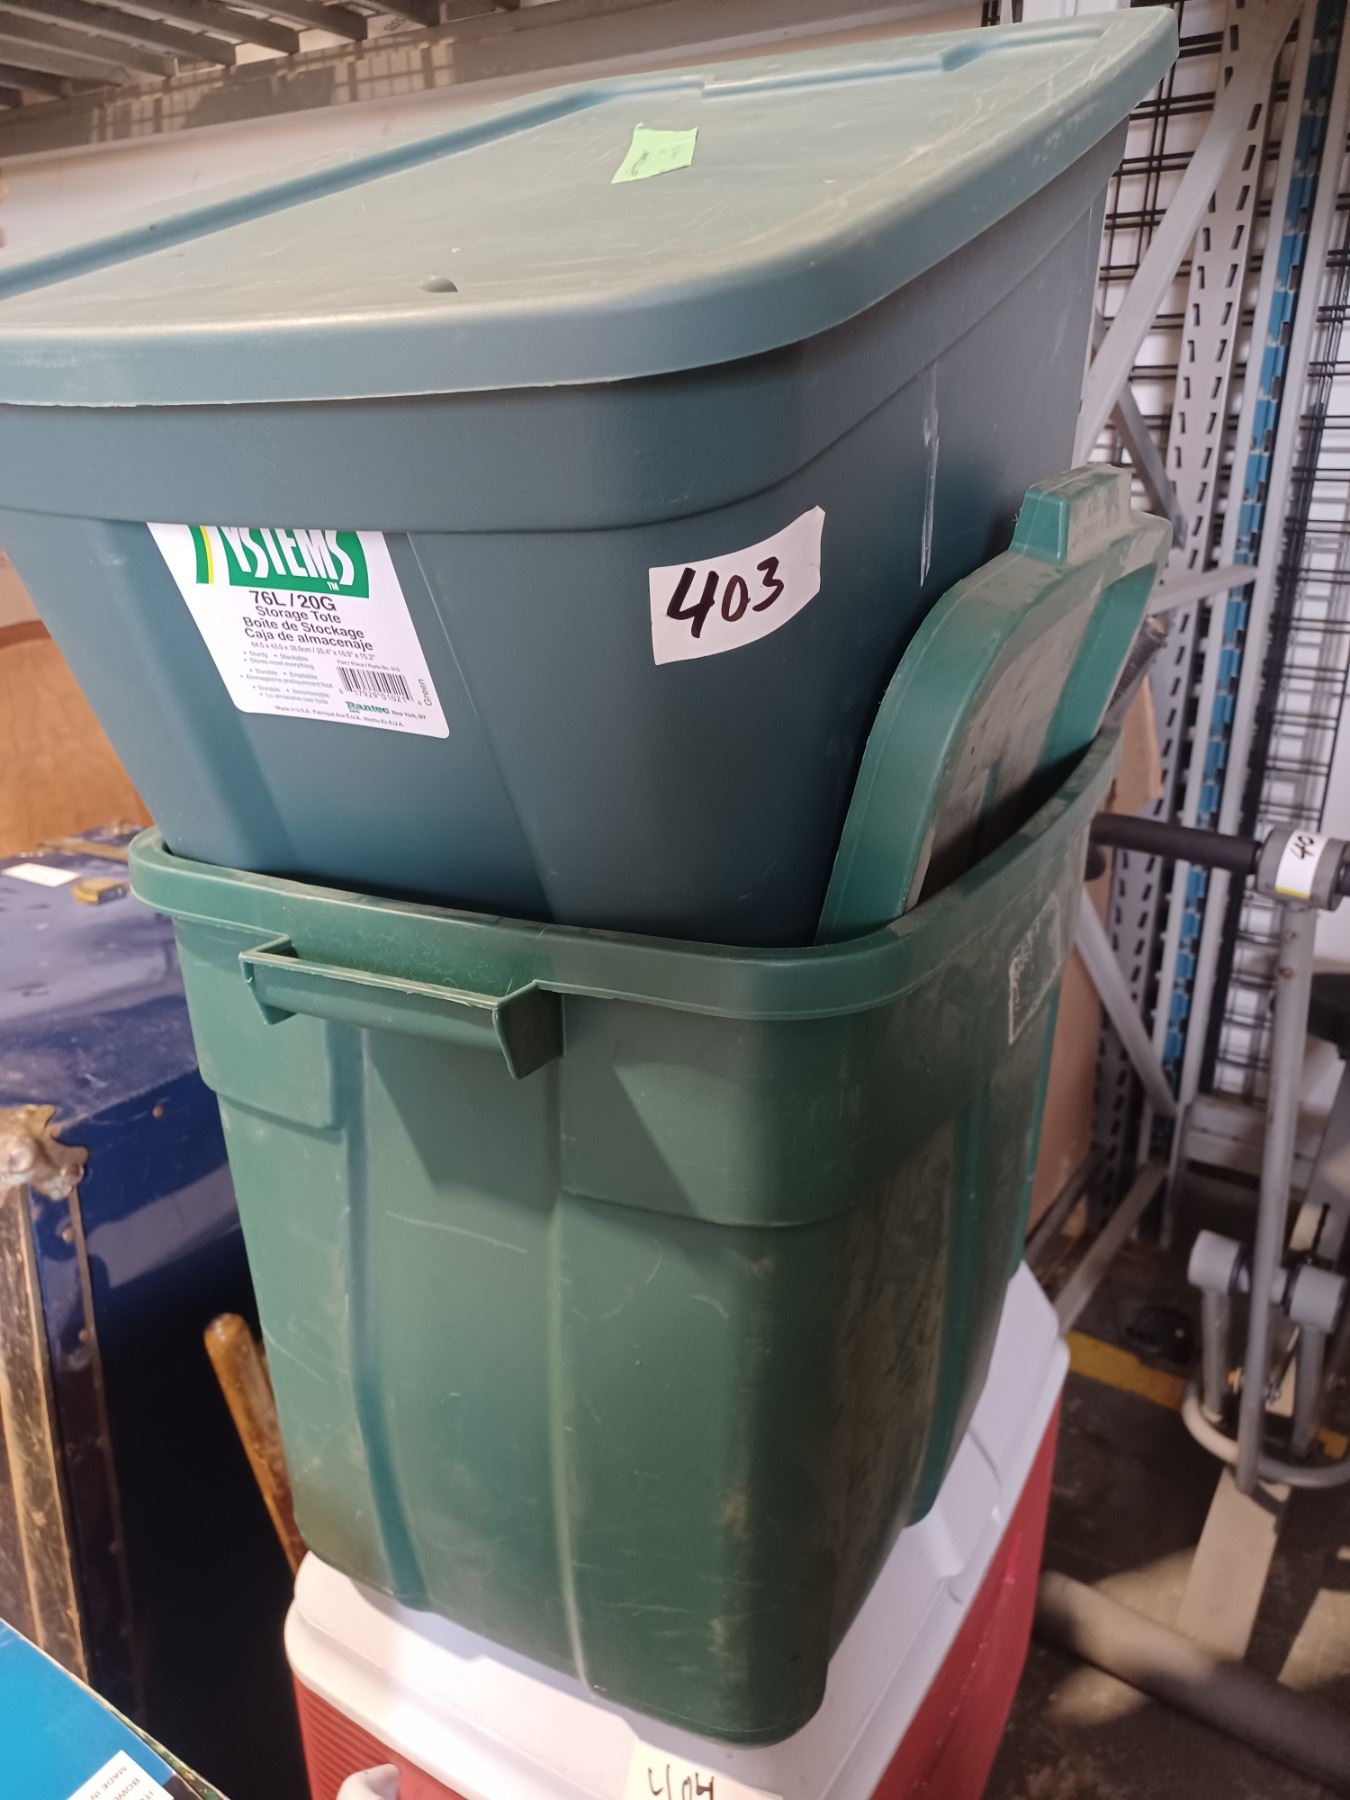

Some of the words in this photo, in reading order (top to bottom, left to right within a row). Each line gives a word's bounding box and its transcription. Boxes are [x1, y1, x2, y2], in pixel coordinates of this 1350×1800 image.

[666, 556, 784, 639] 403
[255, 605, 308, 622] Storage
[310, 610, 342, 624] Tote
[242, 616, 279, 630] Boîte
[281, 620, 299, 632] de
[301, 621, 365, 640] Stockage
[244, 627, 275, 642] Caja
[277, 630, 295, 642] de
[297, 633, 374, 652] almacenaje
